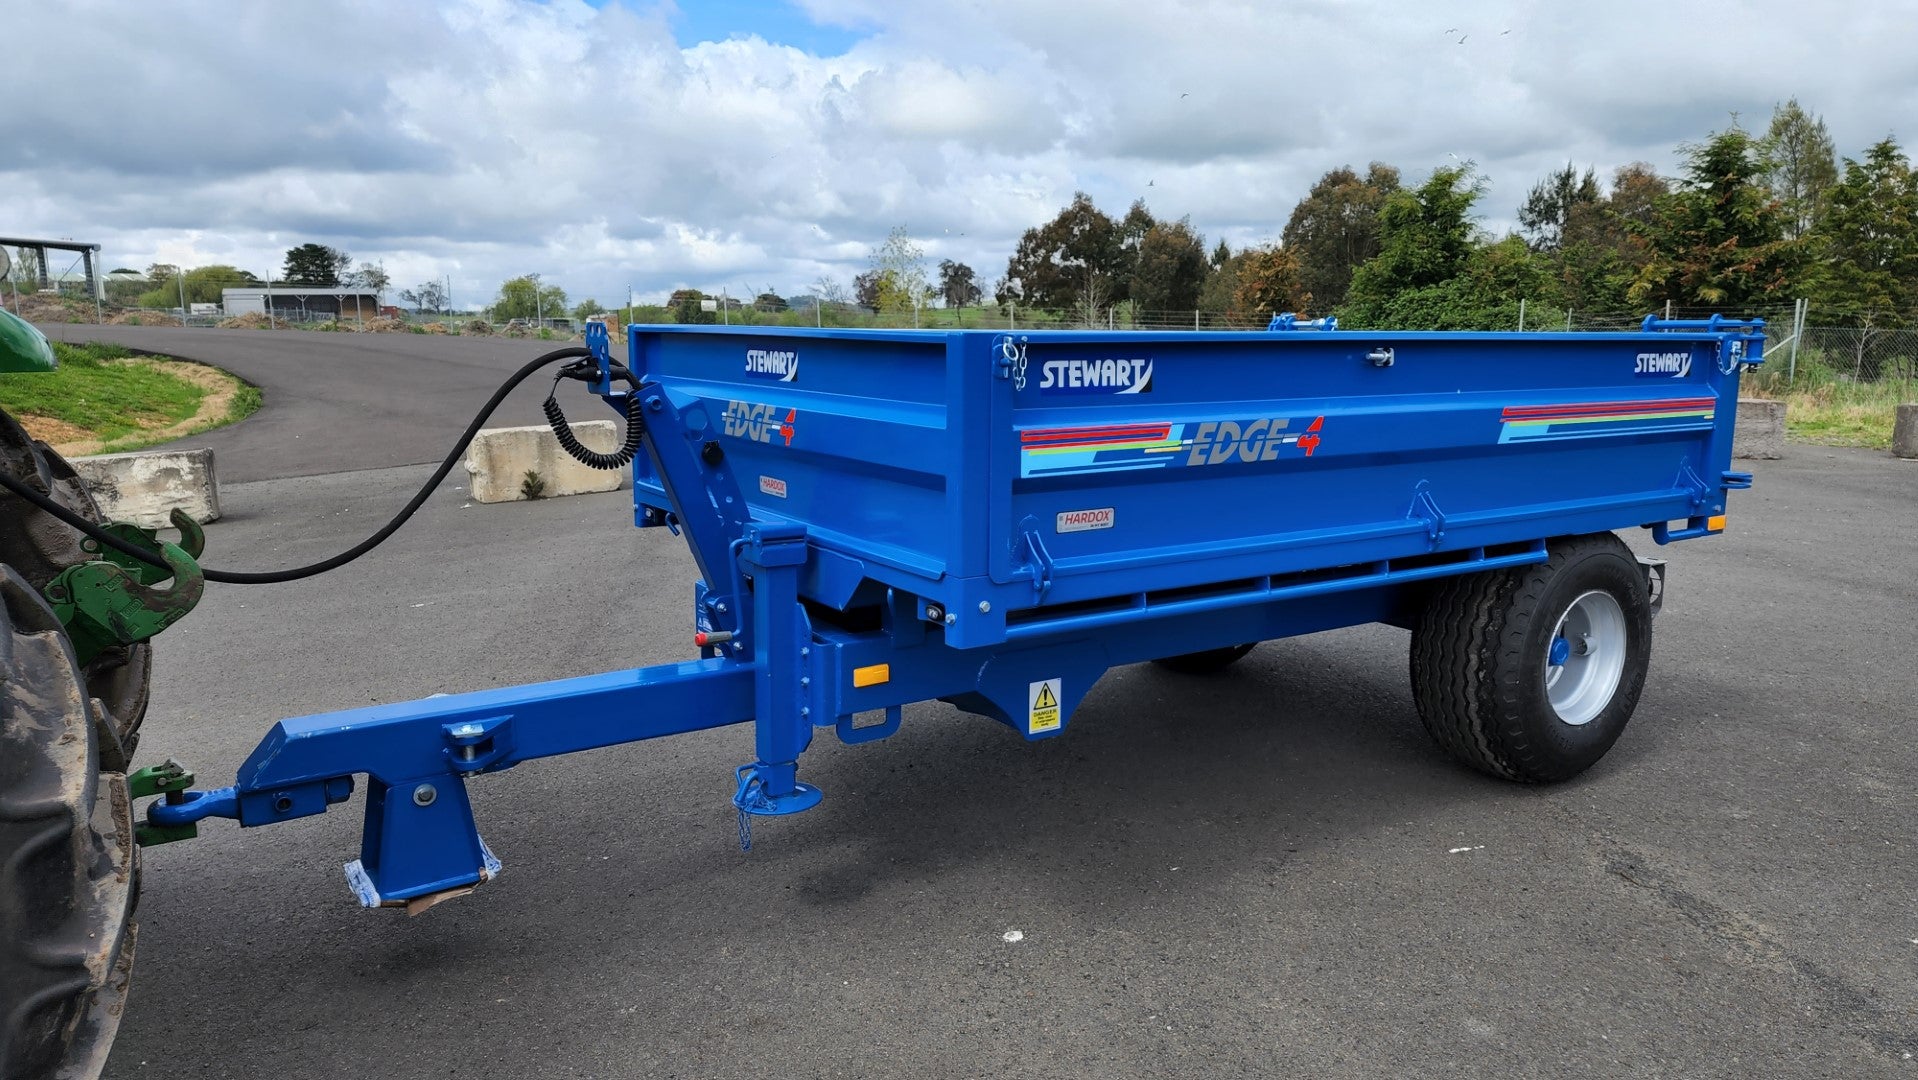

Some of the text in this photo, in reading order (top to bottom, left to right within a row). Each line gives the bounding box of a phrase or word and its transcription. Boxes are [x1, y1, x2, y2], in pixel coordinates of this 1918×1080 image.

[745, 349, 798, 381] STEWART
[1040, 359, 1152, 394] STEWART
[1634, 352, 1692, 378] STEWART
[724, 399, 797, 446] EDGE 4
[1186, 415, 1325, 466] EDGE 4
[1065, 510, 1111, 525] HARDOX
[1033, 709, 1057, 717] DANGER
